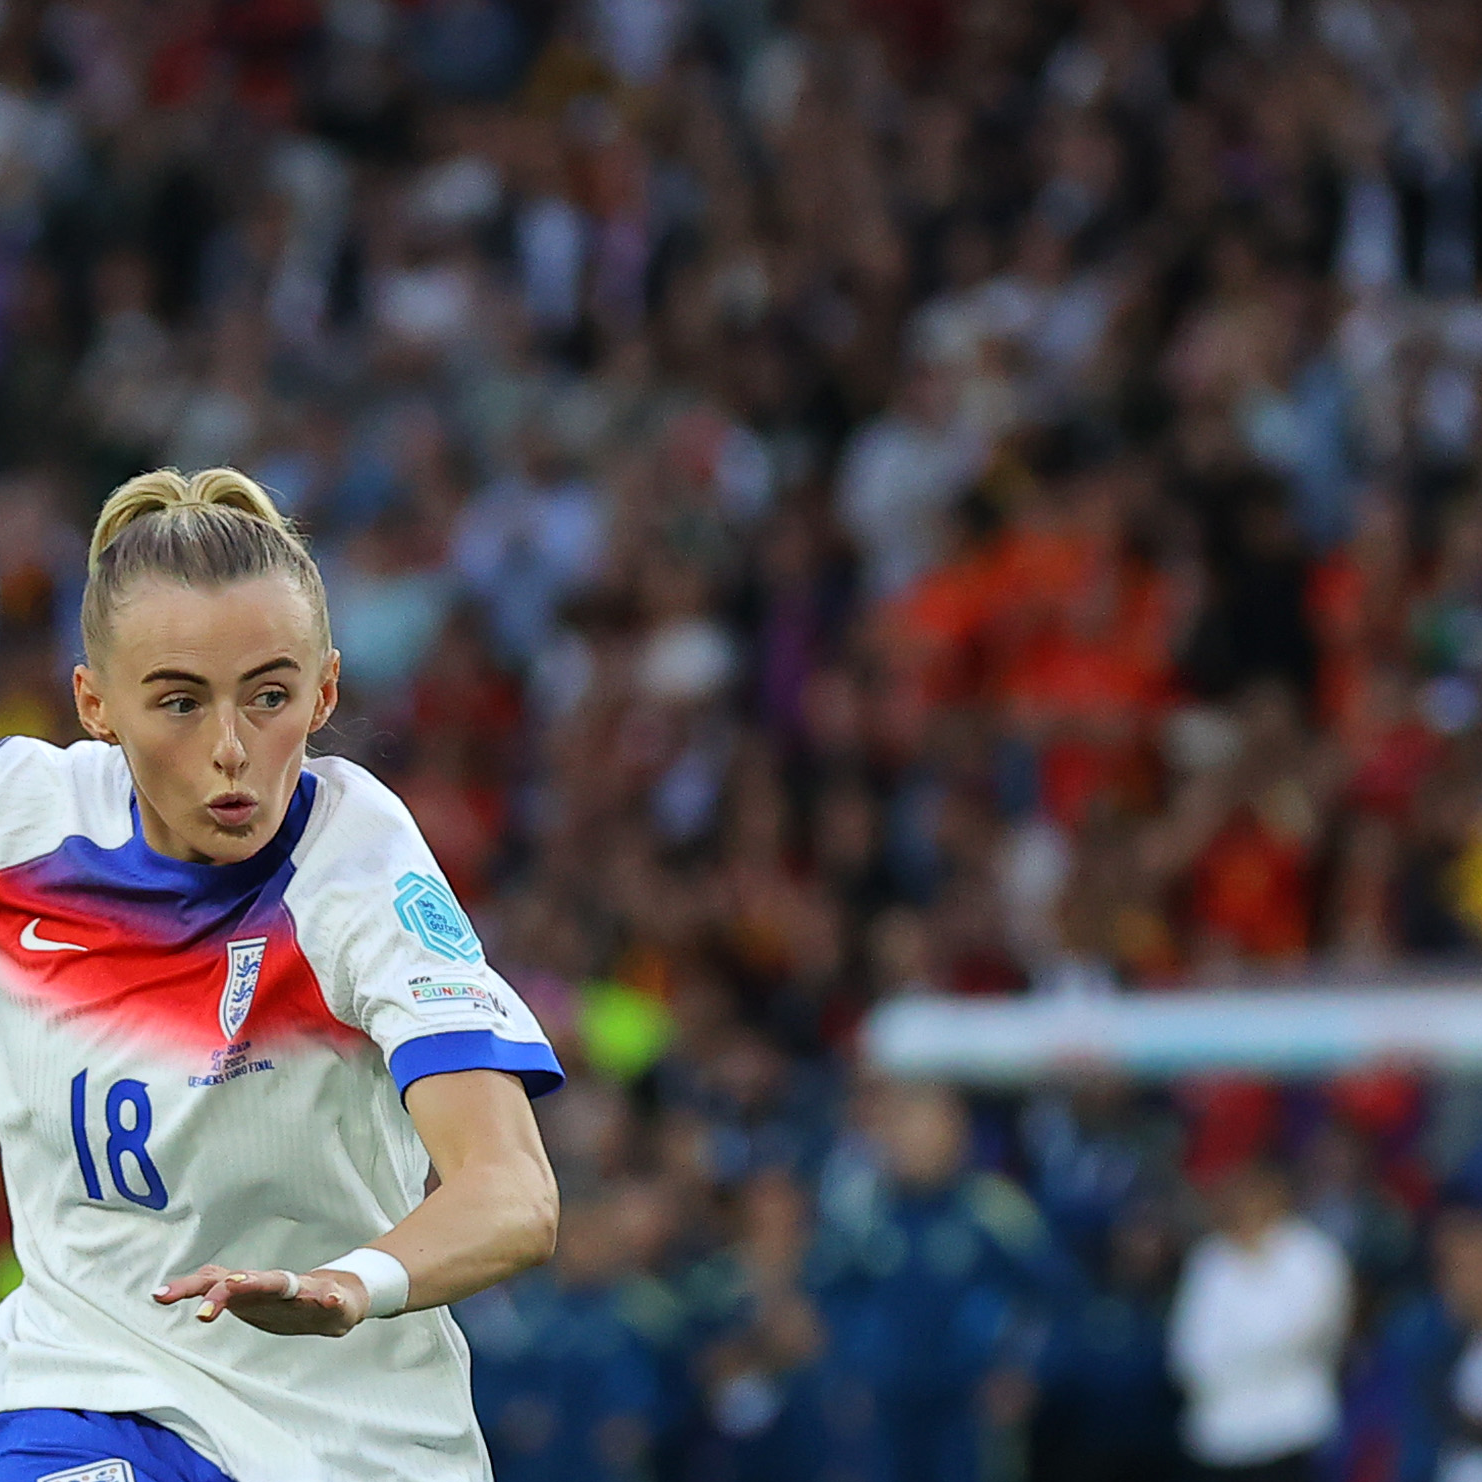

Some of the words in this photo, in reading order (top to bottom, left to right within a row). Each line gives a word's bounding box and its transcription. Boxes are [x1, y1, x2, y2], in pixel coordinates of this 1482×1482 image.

[408, 976, 432, 986] UEFA
[412, 986, 487, 1000] FOUNDATIO
[70, 1066, 169, 1211] 18
